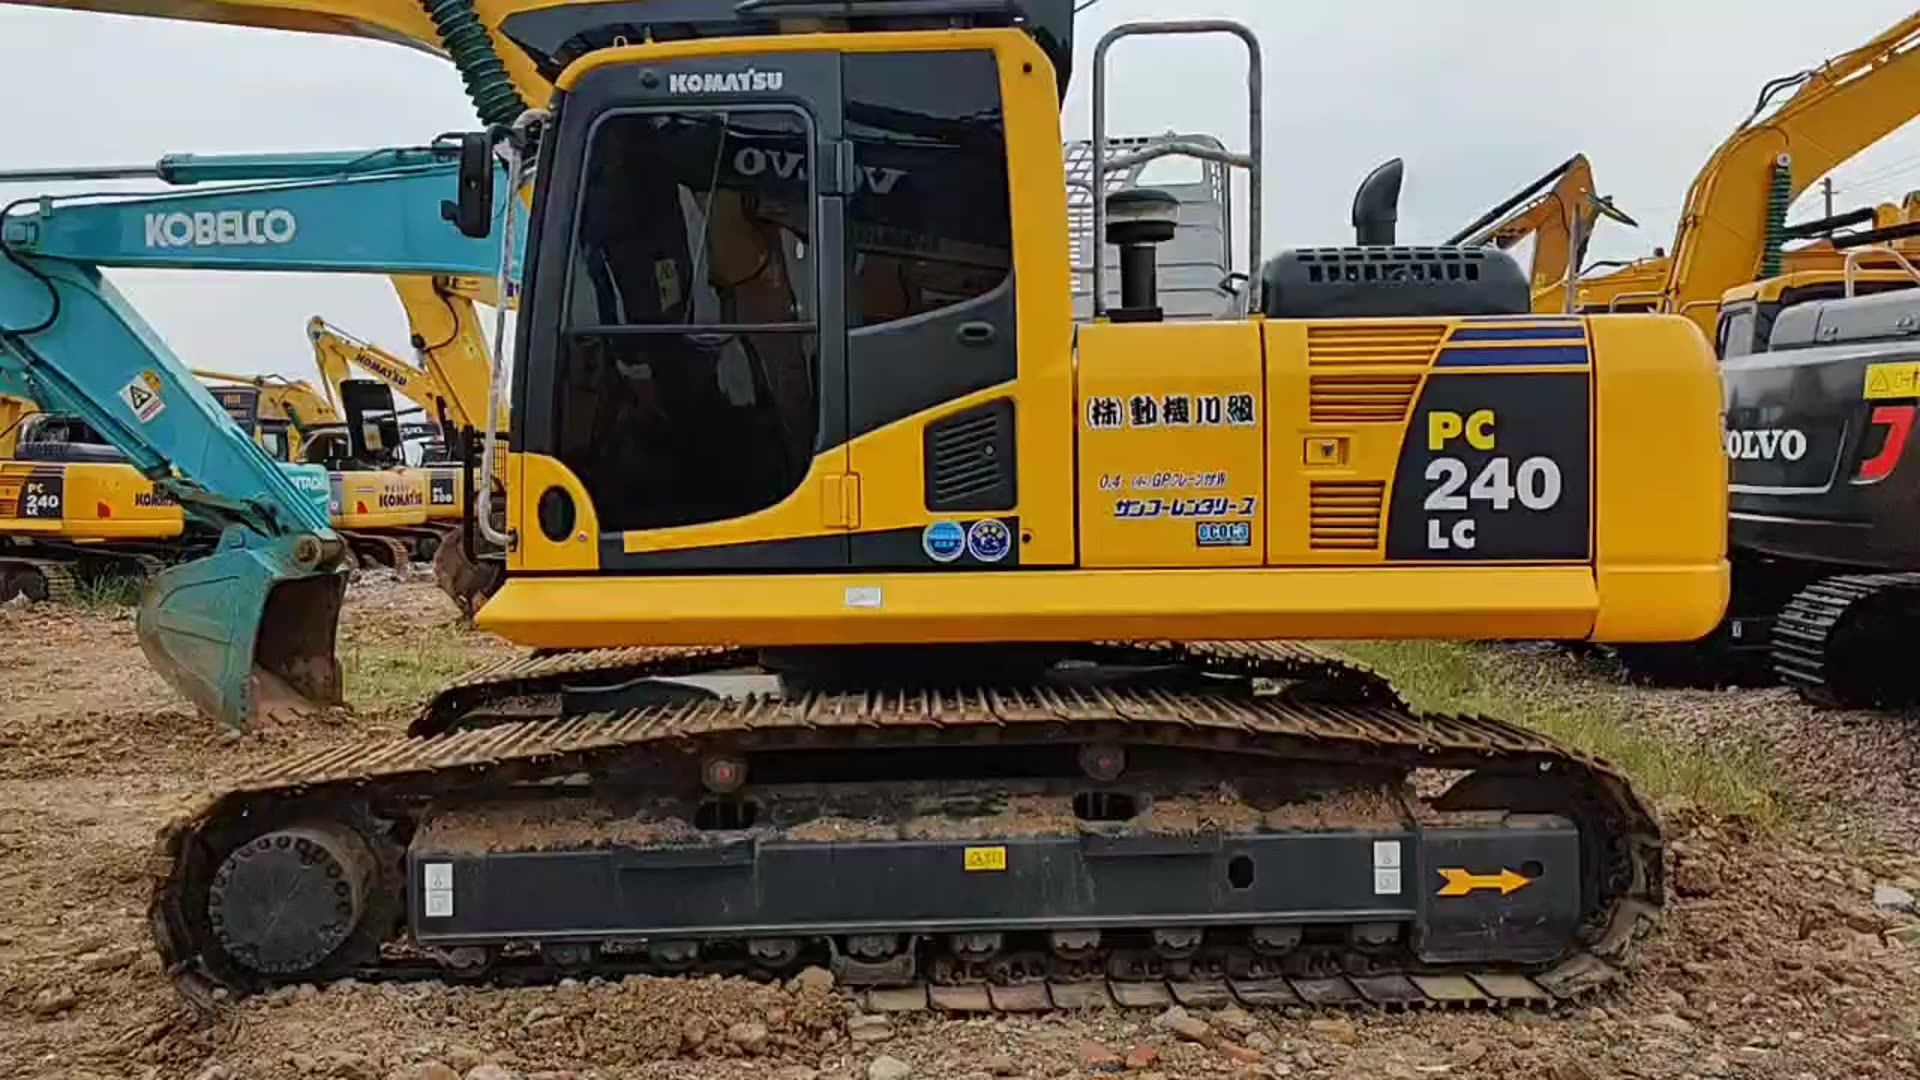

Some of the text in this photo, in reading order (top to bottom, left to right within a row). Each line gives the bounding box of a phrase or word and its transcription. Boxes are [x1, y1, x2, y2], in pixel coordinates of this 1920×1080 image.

[669, 69, 783, 94] KOMATSU
[144, 209, 296, 248] KOBELCO
[1428, 409, 1495, 450] PC
[1725, 428, 1808, 461] OLVO
[1423, 456, 1562, 510] 240
[26, 494, 59, 508] 240
[1428, 519, 1476, 549] LC
